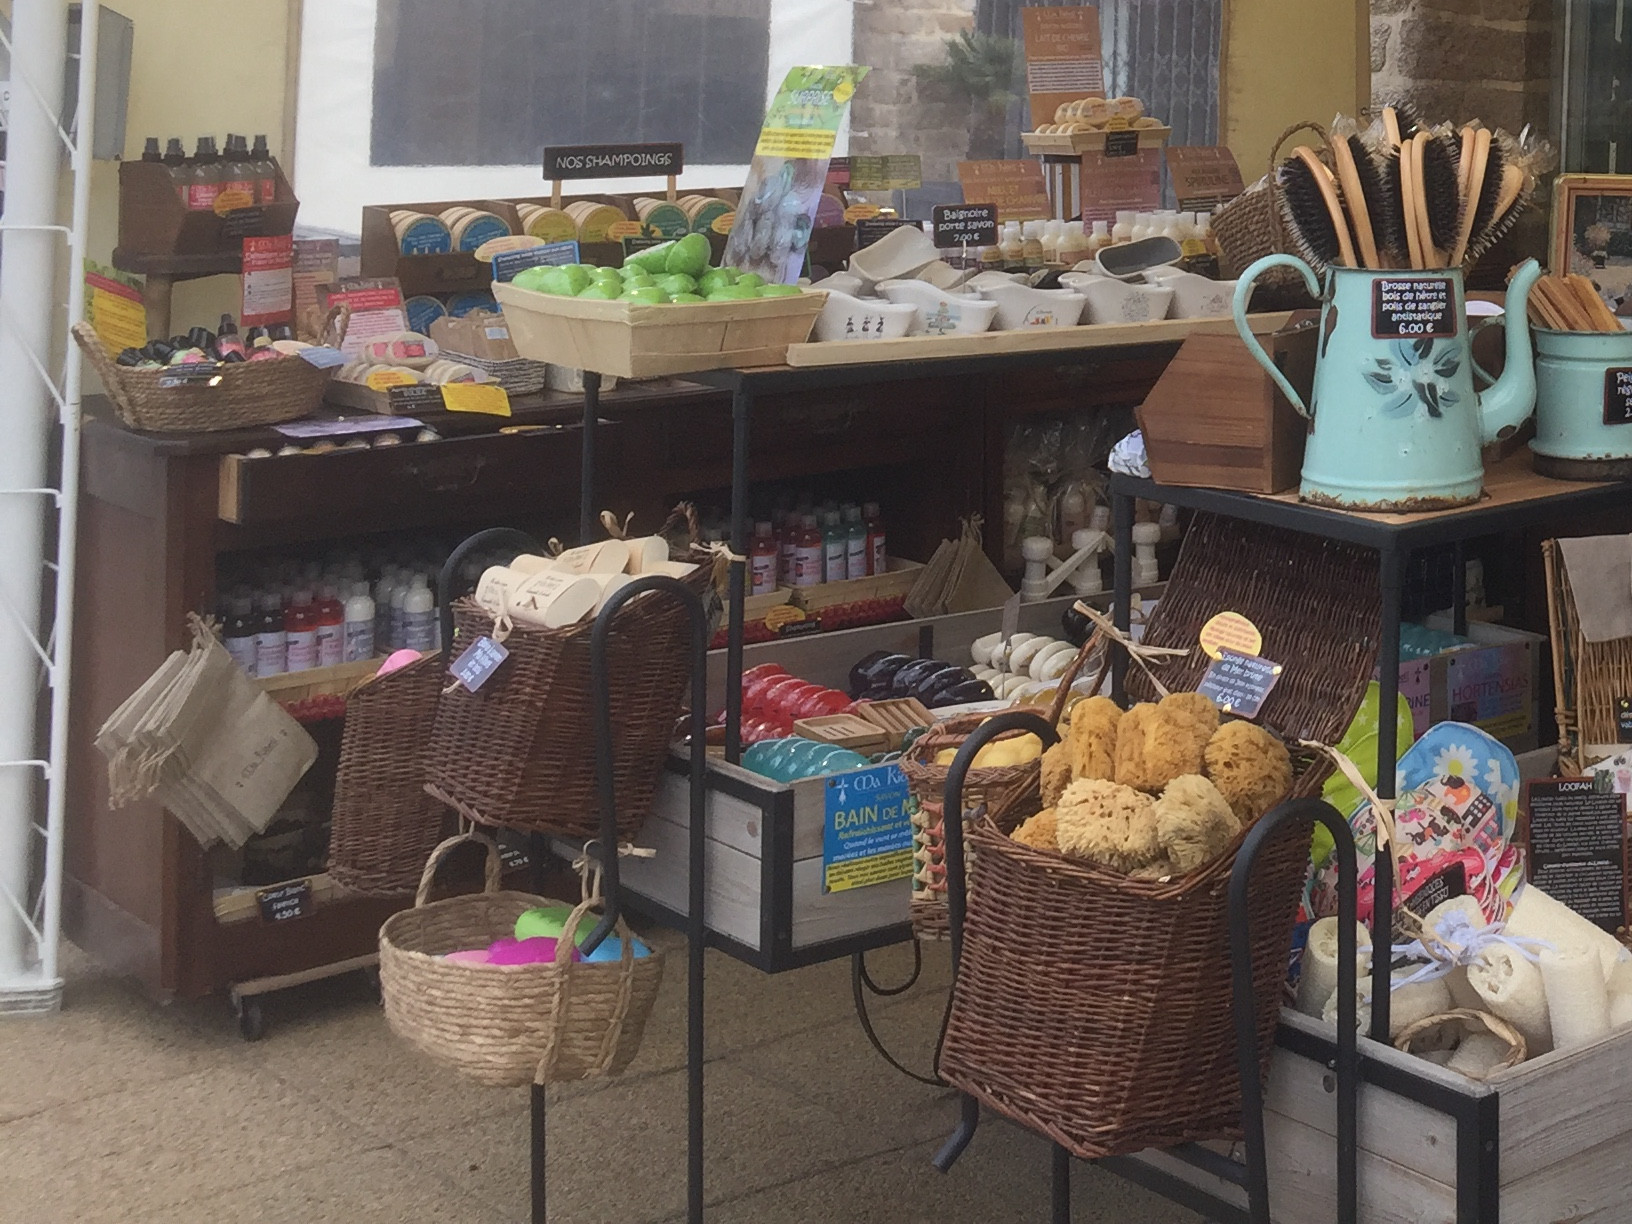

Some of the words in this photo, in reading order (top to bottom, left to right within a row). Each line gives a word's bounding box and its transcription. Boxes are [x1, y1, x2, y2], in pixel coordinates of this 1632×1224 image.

[556, 156, 584, 169] NOS
[585, 153, 672, 169] SHAMPOINGS
[943, 208, 988, 220] Baignoire
[939, 221, 965, 231] porte
[967, 220, 994, 230] savon
[1381, 281, 1411, 291] Brosse
[1382, 291, 1400, 300] bois
[1402, 291, 1414, 300] de
[1404, 301, 1416, 310] de
[1399, 323, 1424, 334] 6.00
[1426, 322, 1434, 333] €
[853, 774, 880, 791] Ma
[1558, 782, 1593, 792] LOOFAH
[834, 804, 878, 830] BAIN
[882, 805, 898, 820] DE
